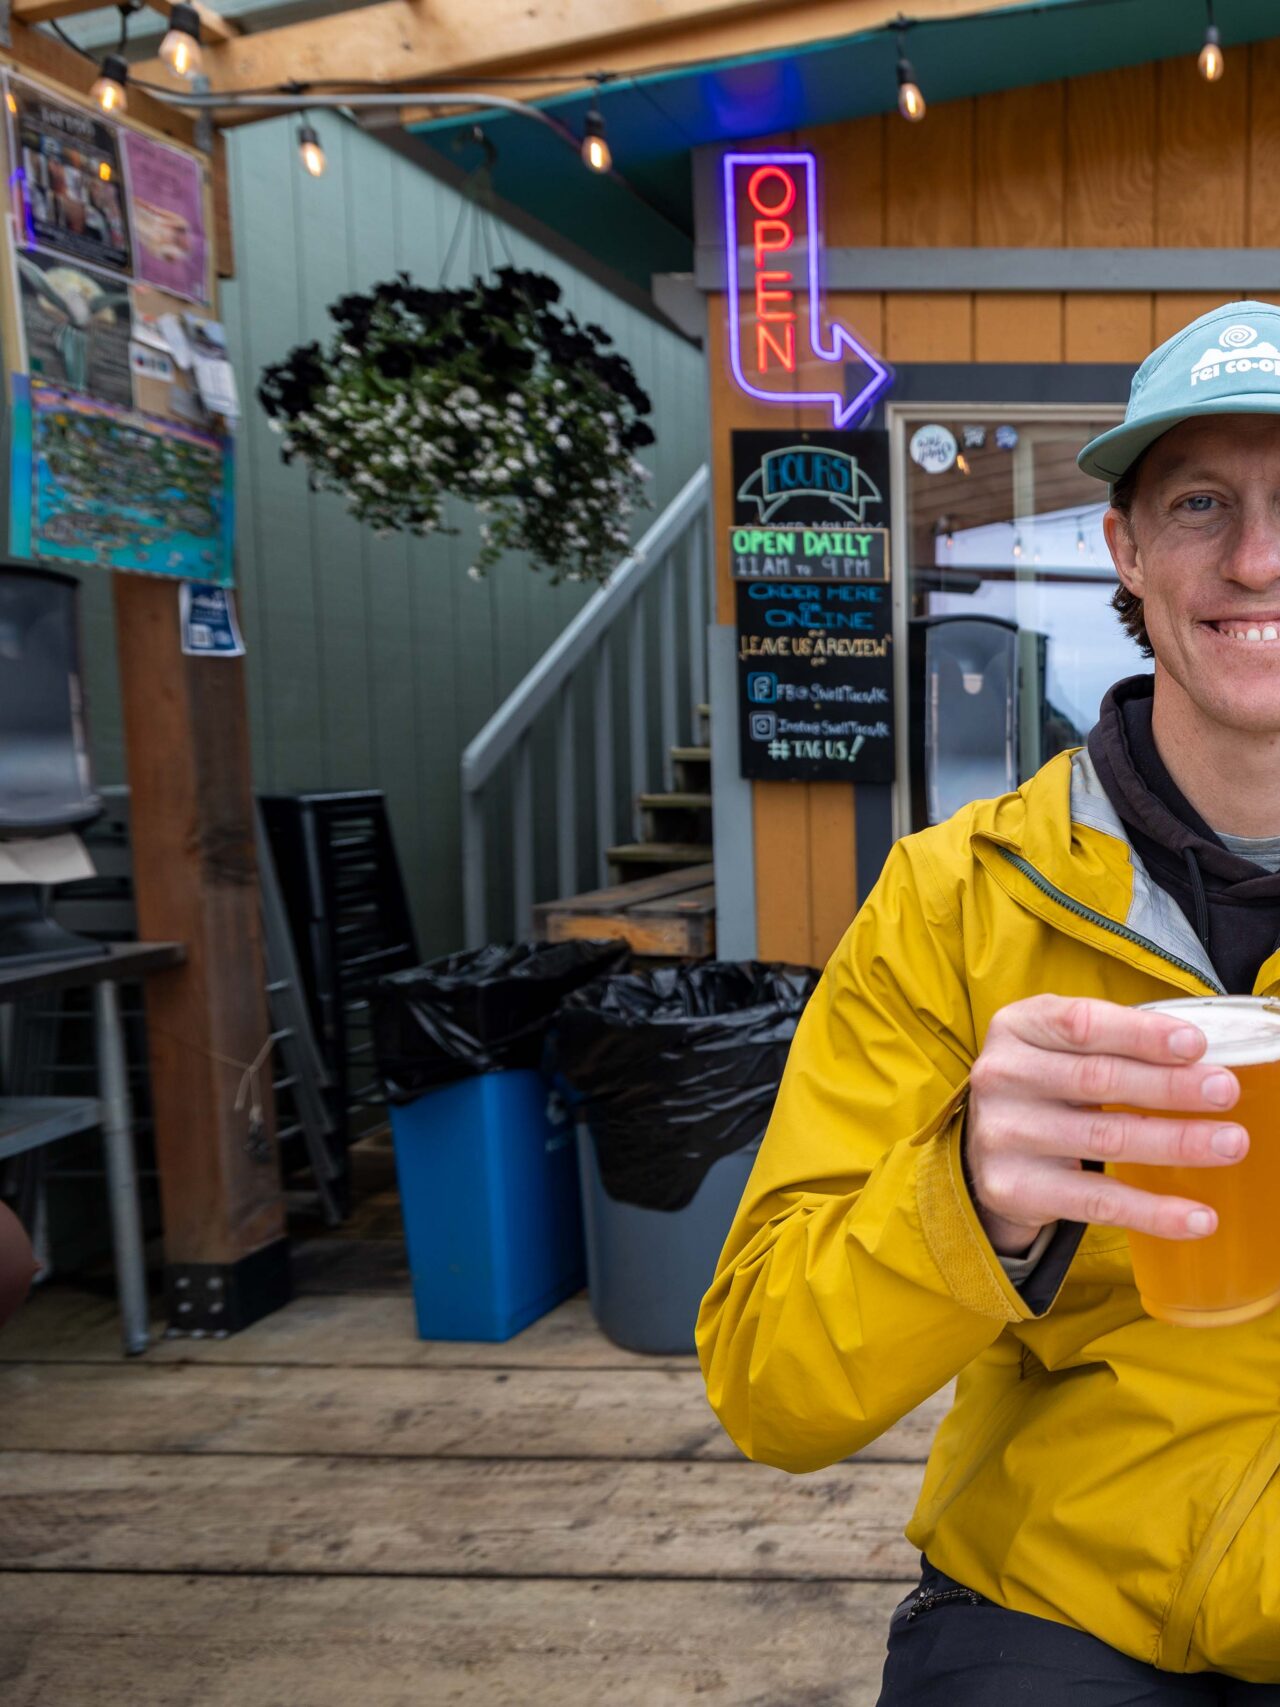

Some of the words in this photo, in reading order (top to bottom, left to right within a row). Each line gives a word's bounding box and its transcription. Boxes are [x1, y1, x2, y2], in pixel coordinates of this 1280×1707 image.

[748, 165, 796, 373] OPEN
[1190, 364, 1220, 387] rei
[767, 453, 850, 494] HOURS
[732, 529, 796, 556] OPEN
[803, 529, 873, 557] DAILY
[747, 582, 822, 601] ORDER
[826, 584, 884, 603] HERE
[764, 608, 875, 630] ONLINE
[740, 635, 790, 657] LEAVE
[792, 637, 813, 657] US
[813, 638, 826, 657] A
[826, 637, 888, 658] REVIEW
